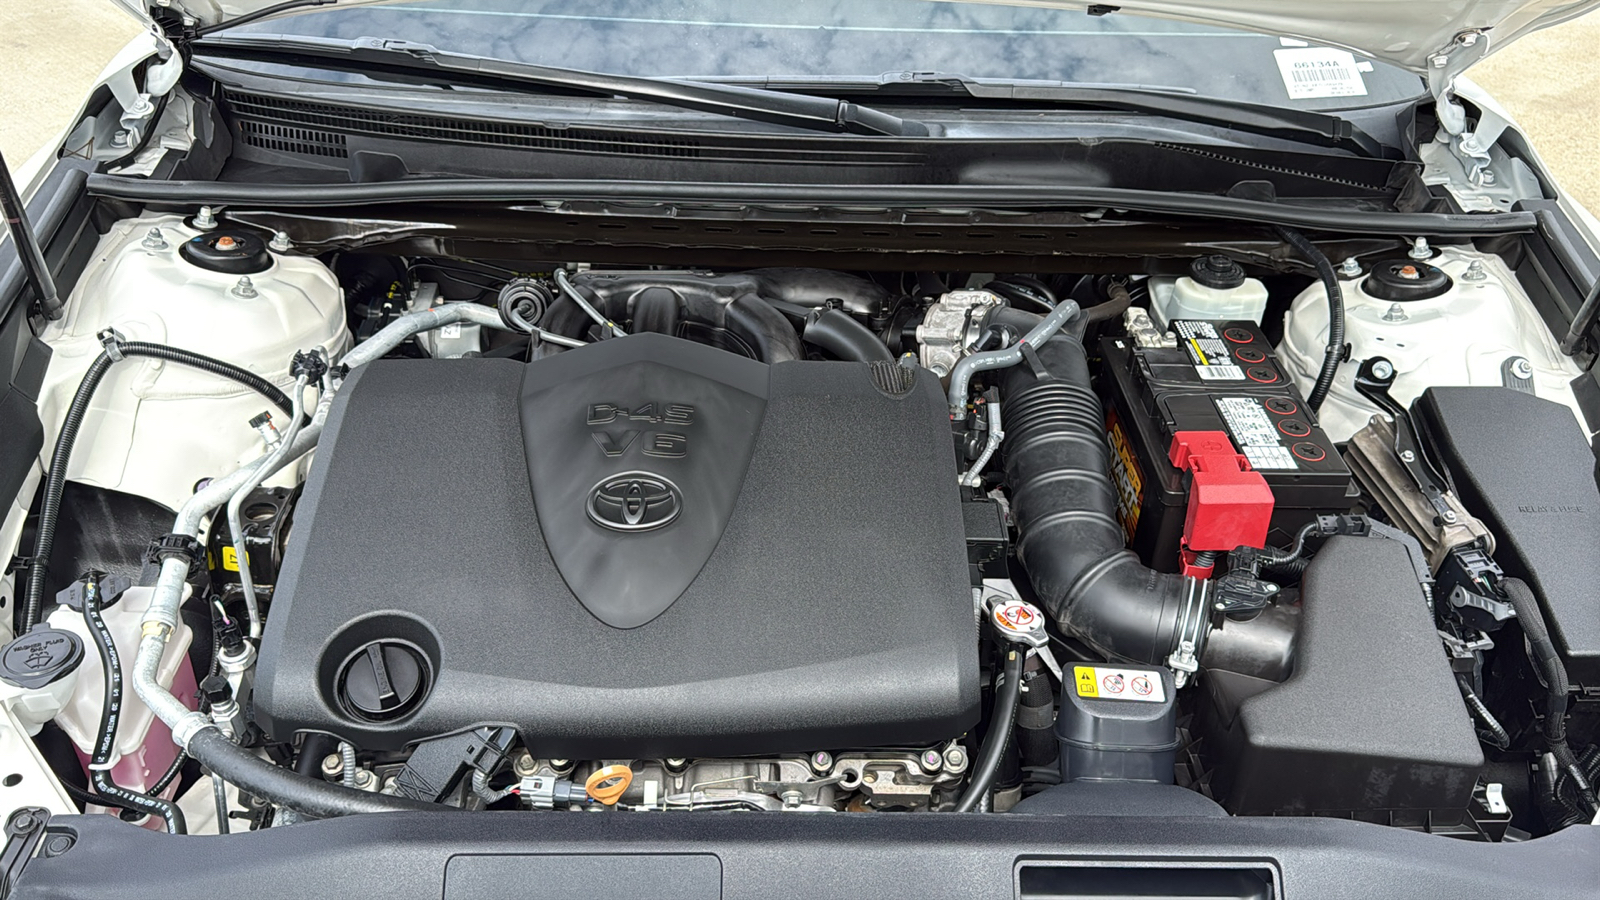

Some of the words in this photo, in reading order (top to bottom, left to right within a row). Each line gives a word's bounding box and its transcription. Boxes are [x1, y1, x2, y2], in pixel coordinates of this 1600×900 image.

[587, 403, 695, 426] D-4S
[591, 431, 688, 459] V6
[1112, 422, 1142, 498] SUPER
[1518, 505, 1548, 513] RELAY
[13, 642, 42, 652] WASHER
[45, 638, 65, 646] FLUID
[101, 630, 113, 647] WATER
[29, 645, 48, 653] ONLY
[106, 714, 117, 733] WATER
